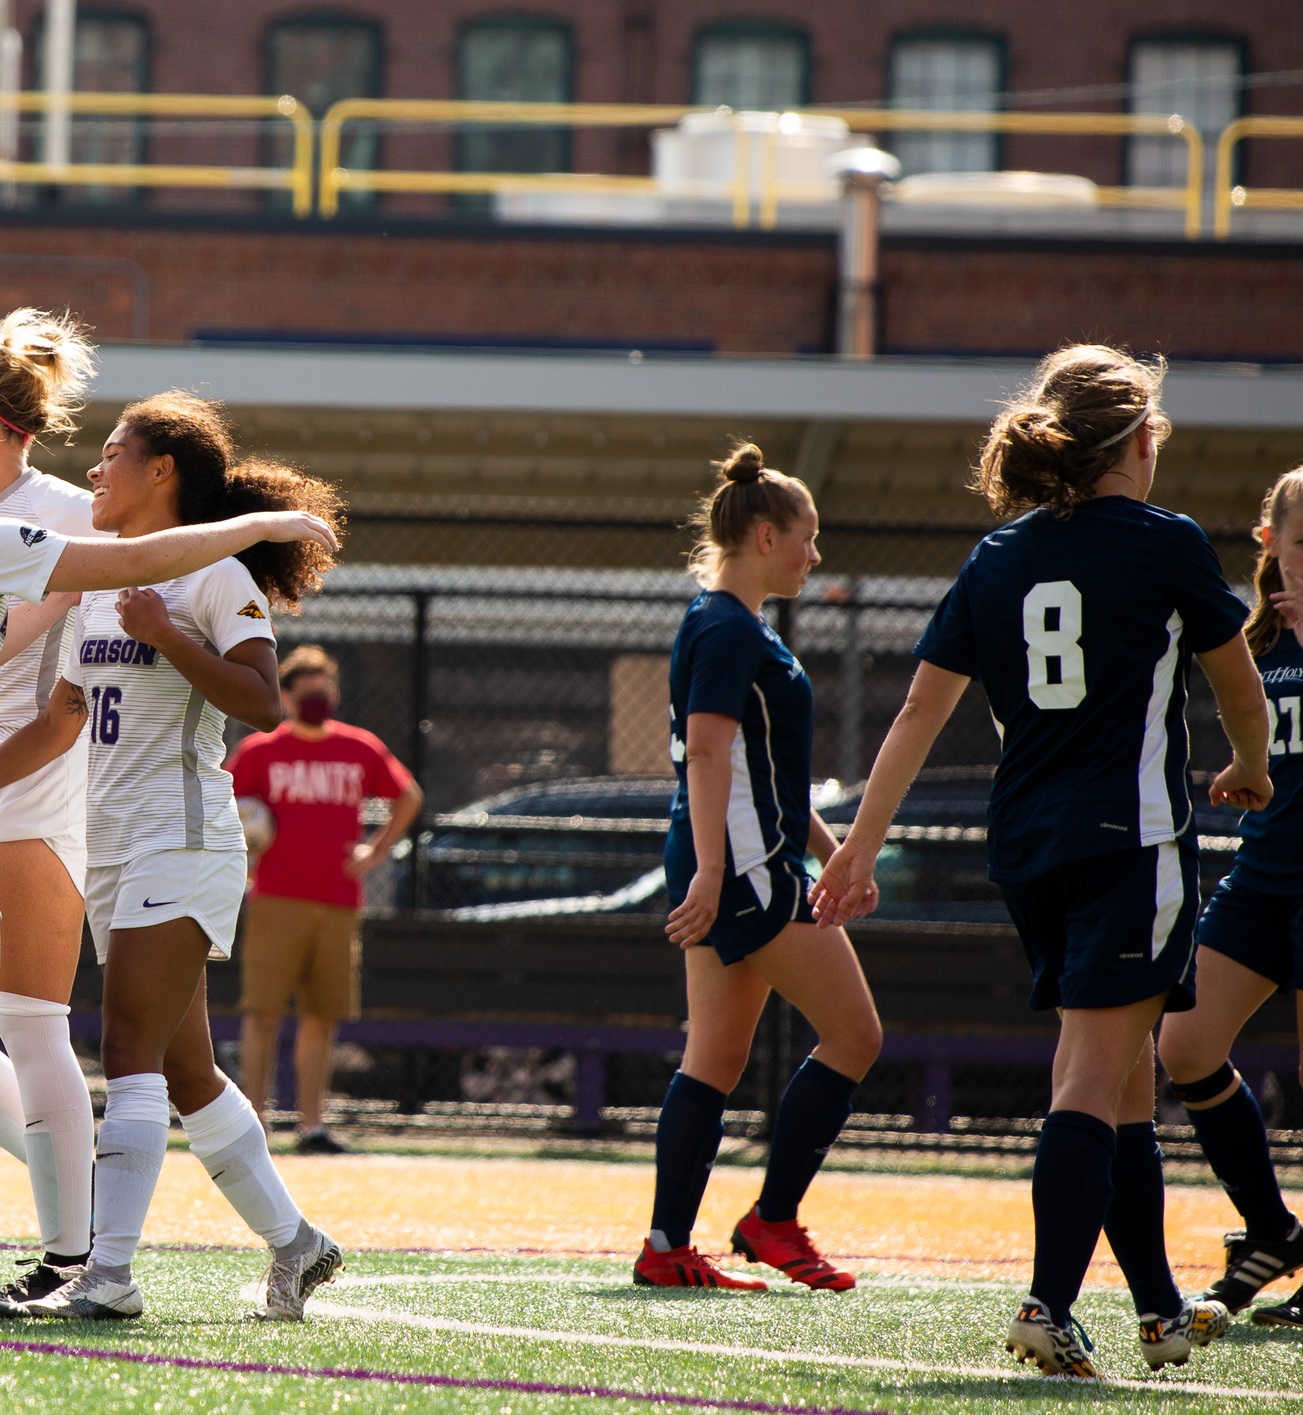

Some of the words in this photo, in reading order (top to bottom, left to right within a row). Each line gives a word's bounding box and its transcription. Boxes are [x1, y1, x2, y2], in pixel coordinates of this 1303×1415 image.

[80, 639, 158, 667] ERSON
[1023, 580, 1087, 710] 8
[91, 685, 122, 745] 16
